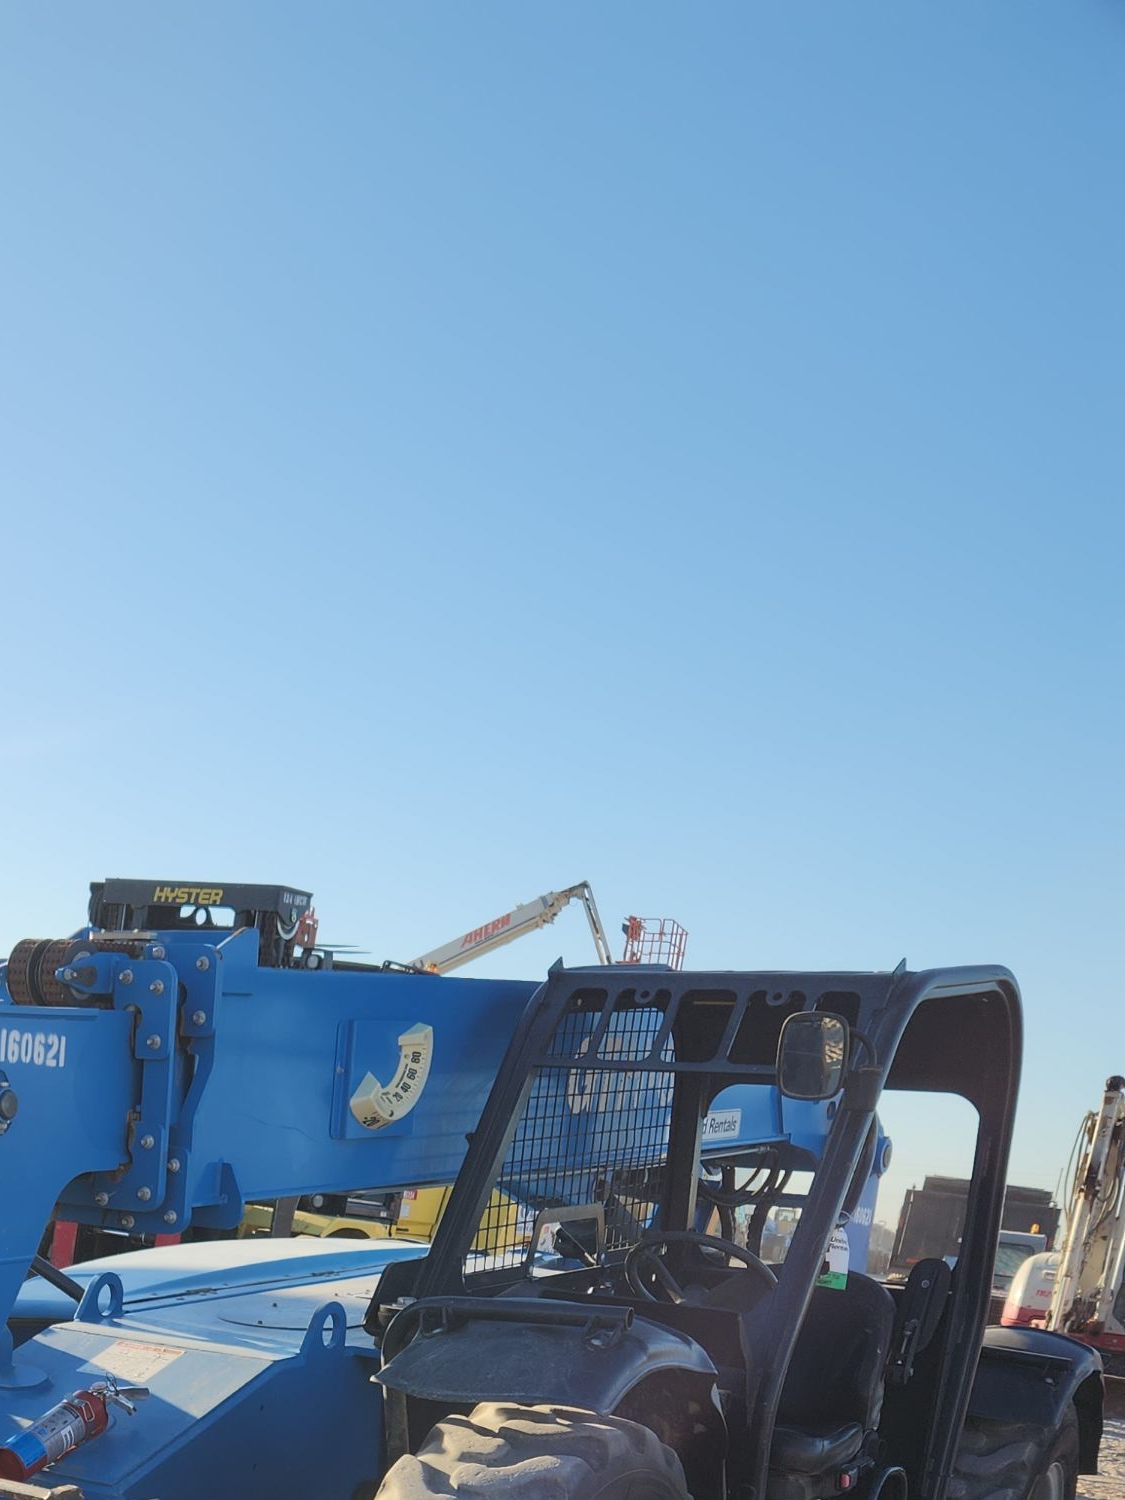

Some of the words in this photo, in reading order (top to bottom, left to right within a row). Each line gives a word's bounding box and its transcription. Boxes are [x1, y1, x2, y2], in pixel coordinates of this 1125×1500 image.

[153, 886, 224, 905] HYSTER
[460, 912, 512, 949] AHERN
[0, 1028, 67, 1068] 160621
[410, 1051, 422, 1064] 80
[406, 1067, 418, 1081] 60
[400, 1081, 412, 1093] 40
[708, 1115, 737, 1135] Rentals
